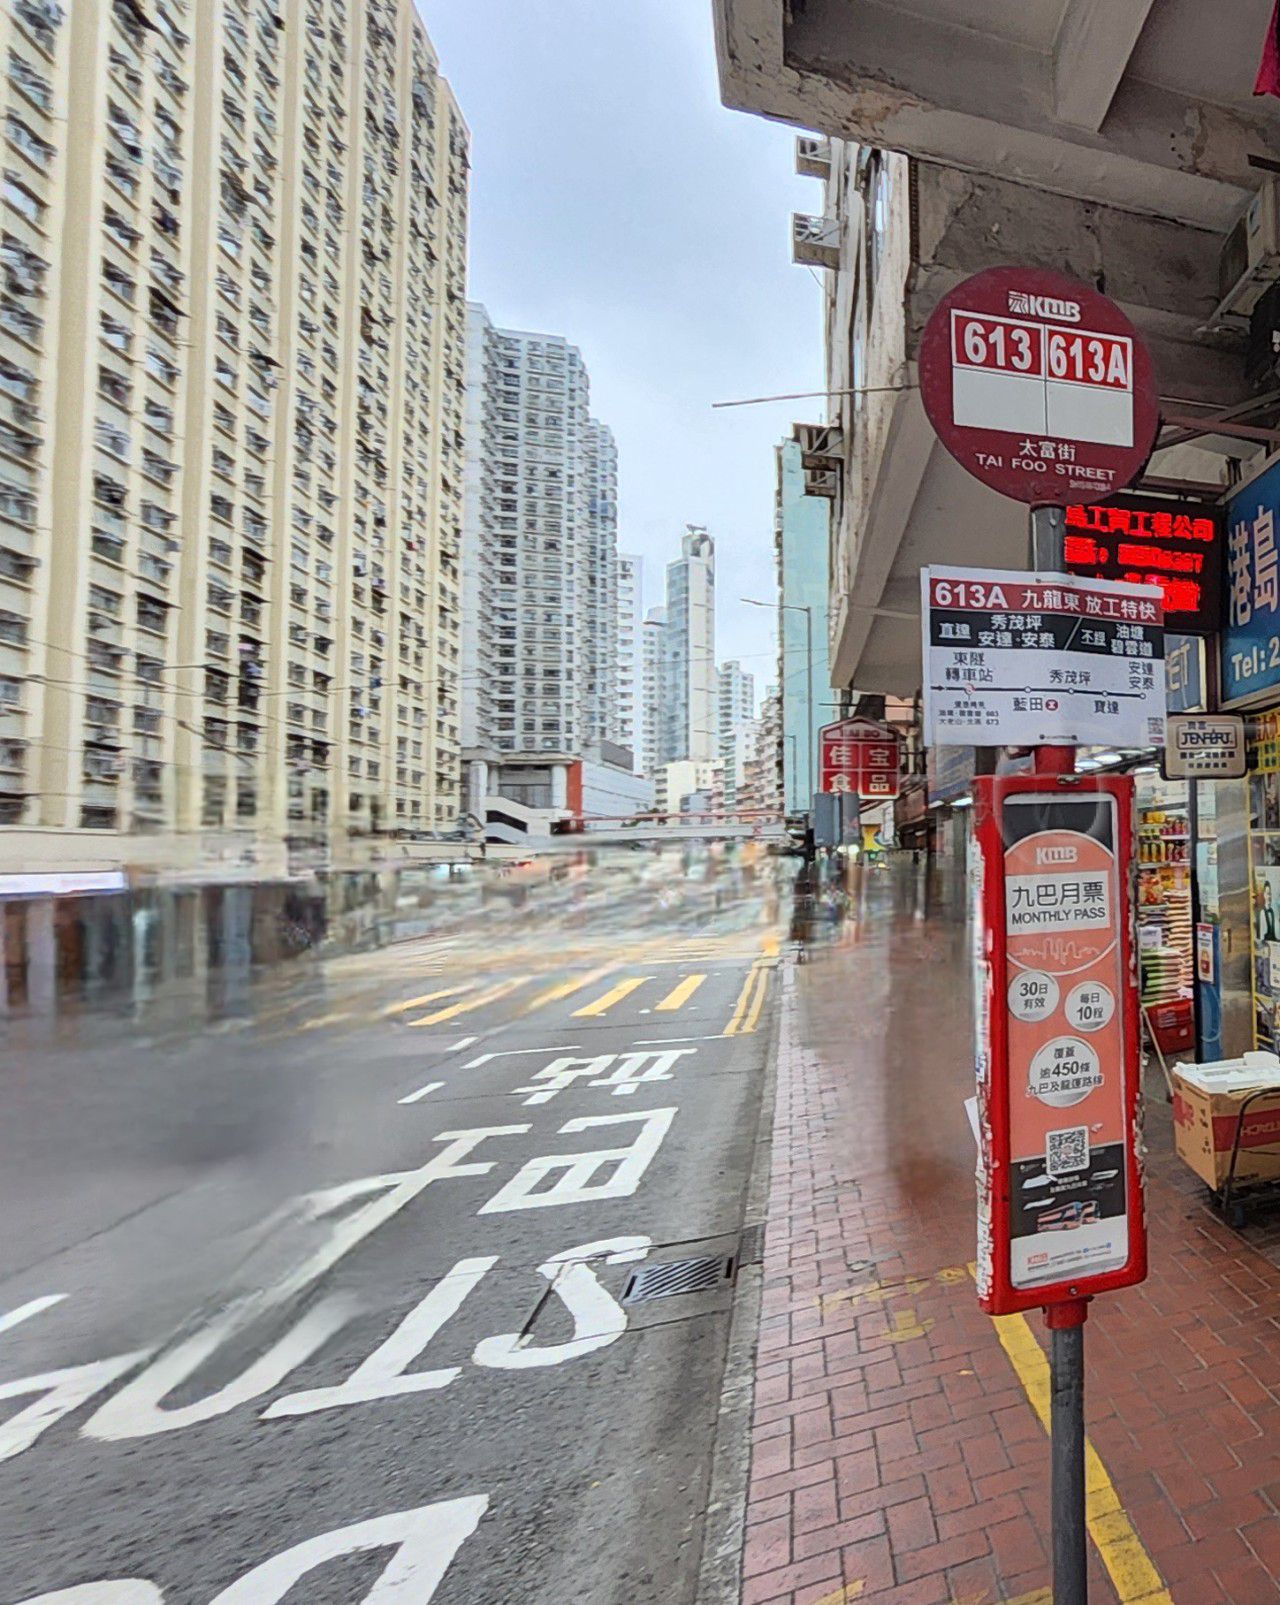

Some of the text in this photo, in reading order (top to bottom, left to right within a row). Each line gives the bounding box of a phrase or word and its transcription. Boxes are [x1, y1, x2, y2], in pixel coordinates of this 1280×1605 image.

[1029, 294, 1081, 322] KMB
[964, 321, 1128, 385] 613 613A
[1019, 438, 1076, 462] 太富街
[975, 452, 1116, 481] TAI FOO STREET
[935, 582, 1156, 621] 613A 九龍東 放工特快
[939, 622, 971, 640] 直達
[990, 614, 1043, 631] 秀茂坪
[945, 667, 993, 683] 轉車站
[1049, 668, 1091, 686] 秀茂坪
[1013, 696, 1044, 712] 藍田
[1035, 847, 1078, 865] KMB
[1011, 880, 1105, 909] 九巴月票
[1011, 907, 1107, 926] MONTHLY PASS
[1019, 982, 1049, 997] 30日
[1023, 997, 1046, 1010] 有效
